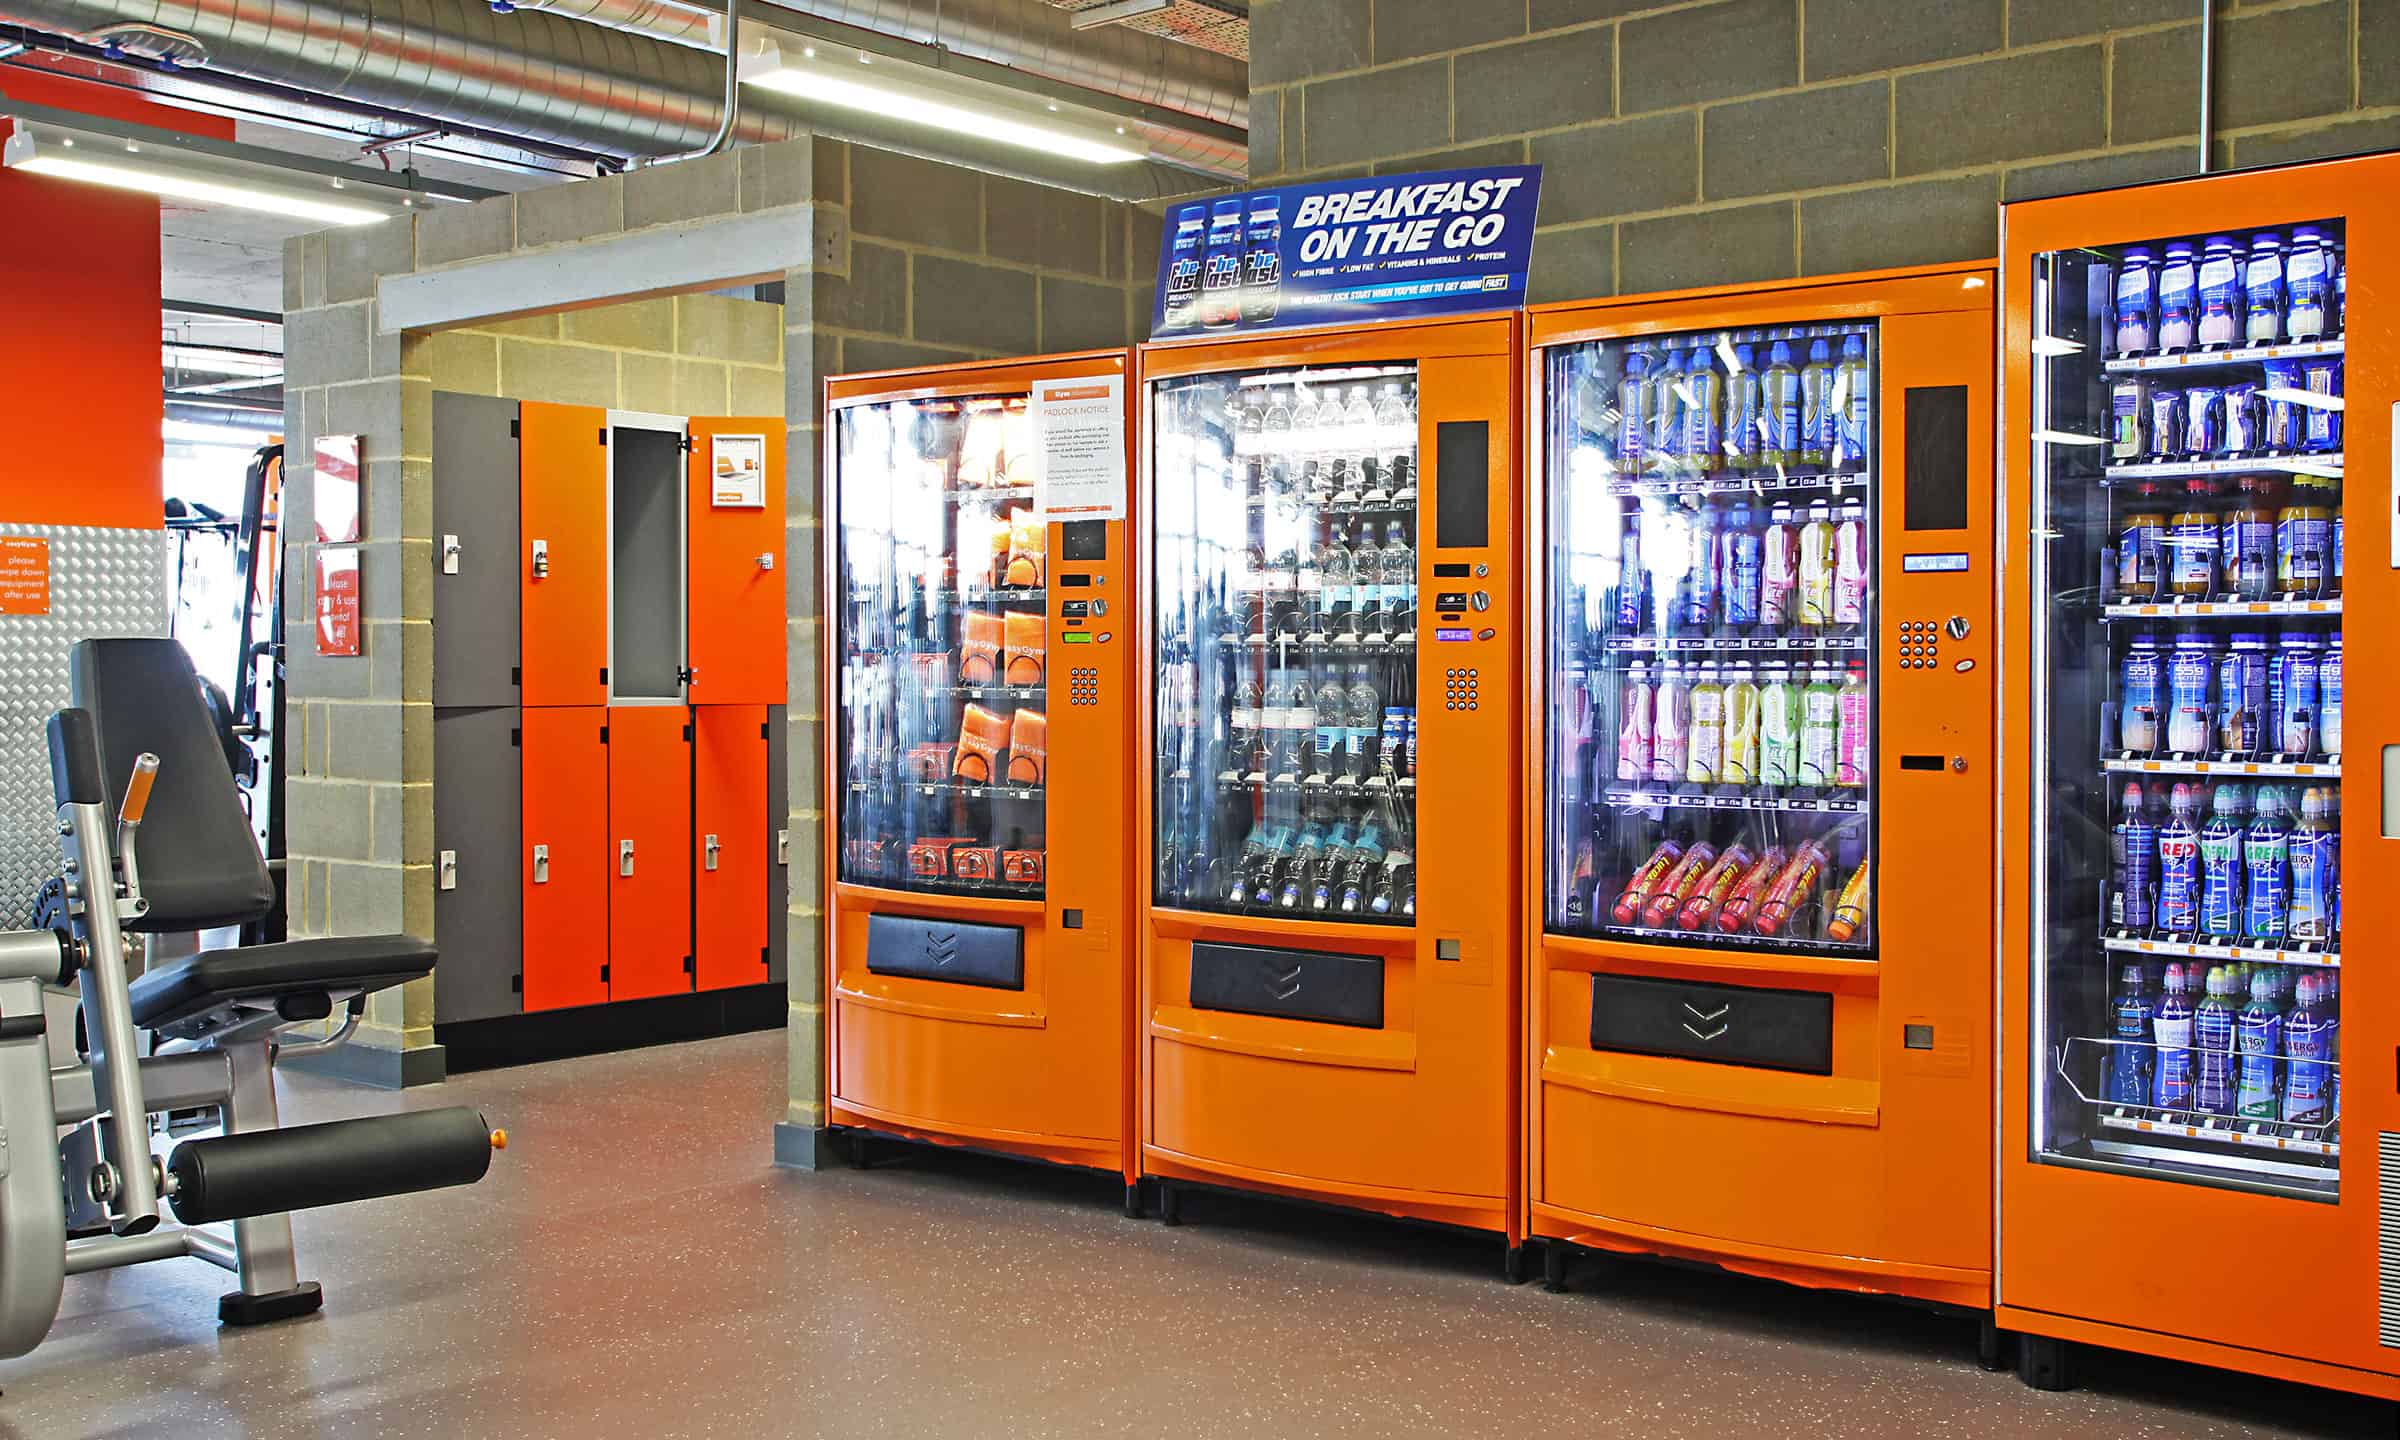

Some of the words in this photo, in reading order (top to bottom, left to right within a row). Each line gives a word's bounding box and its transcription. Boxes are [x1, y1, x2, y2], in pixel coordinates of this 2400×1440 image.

[1293, 178, 1524, 229] BREAKFAST
[1300, 227, 1358, 263] ON
[1361, 219, 1440, 257] THE
[1443, 214, 1506, 248] GO
[1346, 264, 1362, 273] LOW
[1361, 263, 1376, 272] FAT
[1474, 251, 1506, 261] PROTEIN
[1485, 278, 1505, 288] FAST
[1044, 407, 1079, 417] PADLOCK
[1080, 405, 1110, 415] NOTICE
[8, 556, 36, 566] please
[22, 567, 45, 577] down
[4, 591, 24, 600] after
[2162, 842, 2196, 857] RED
